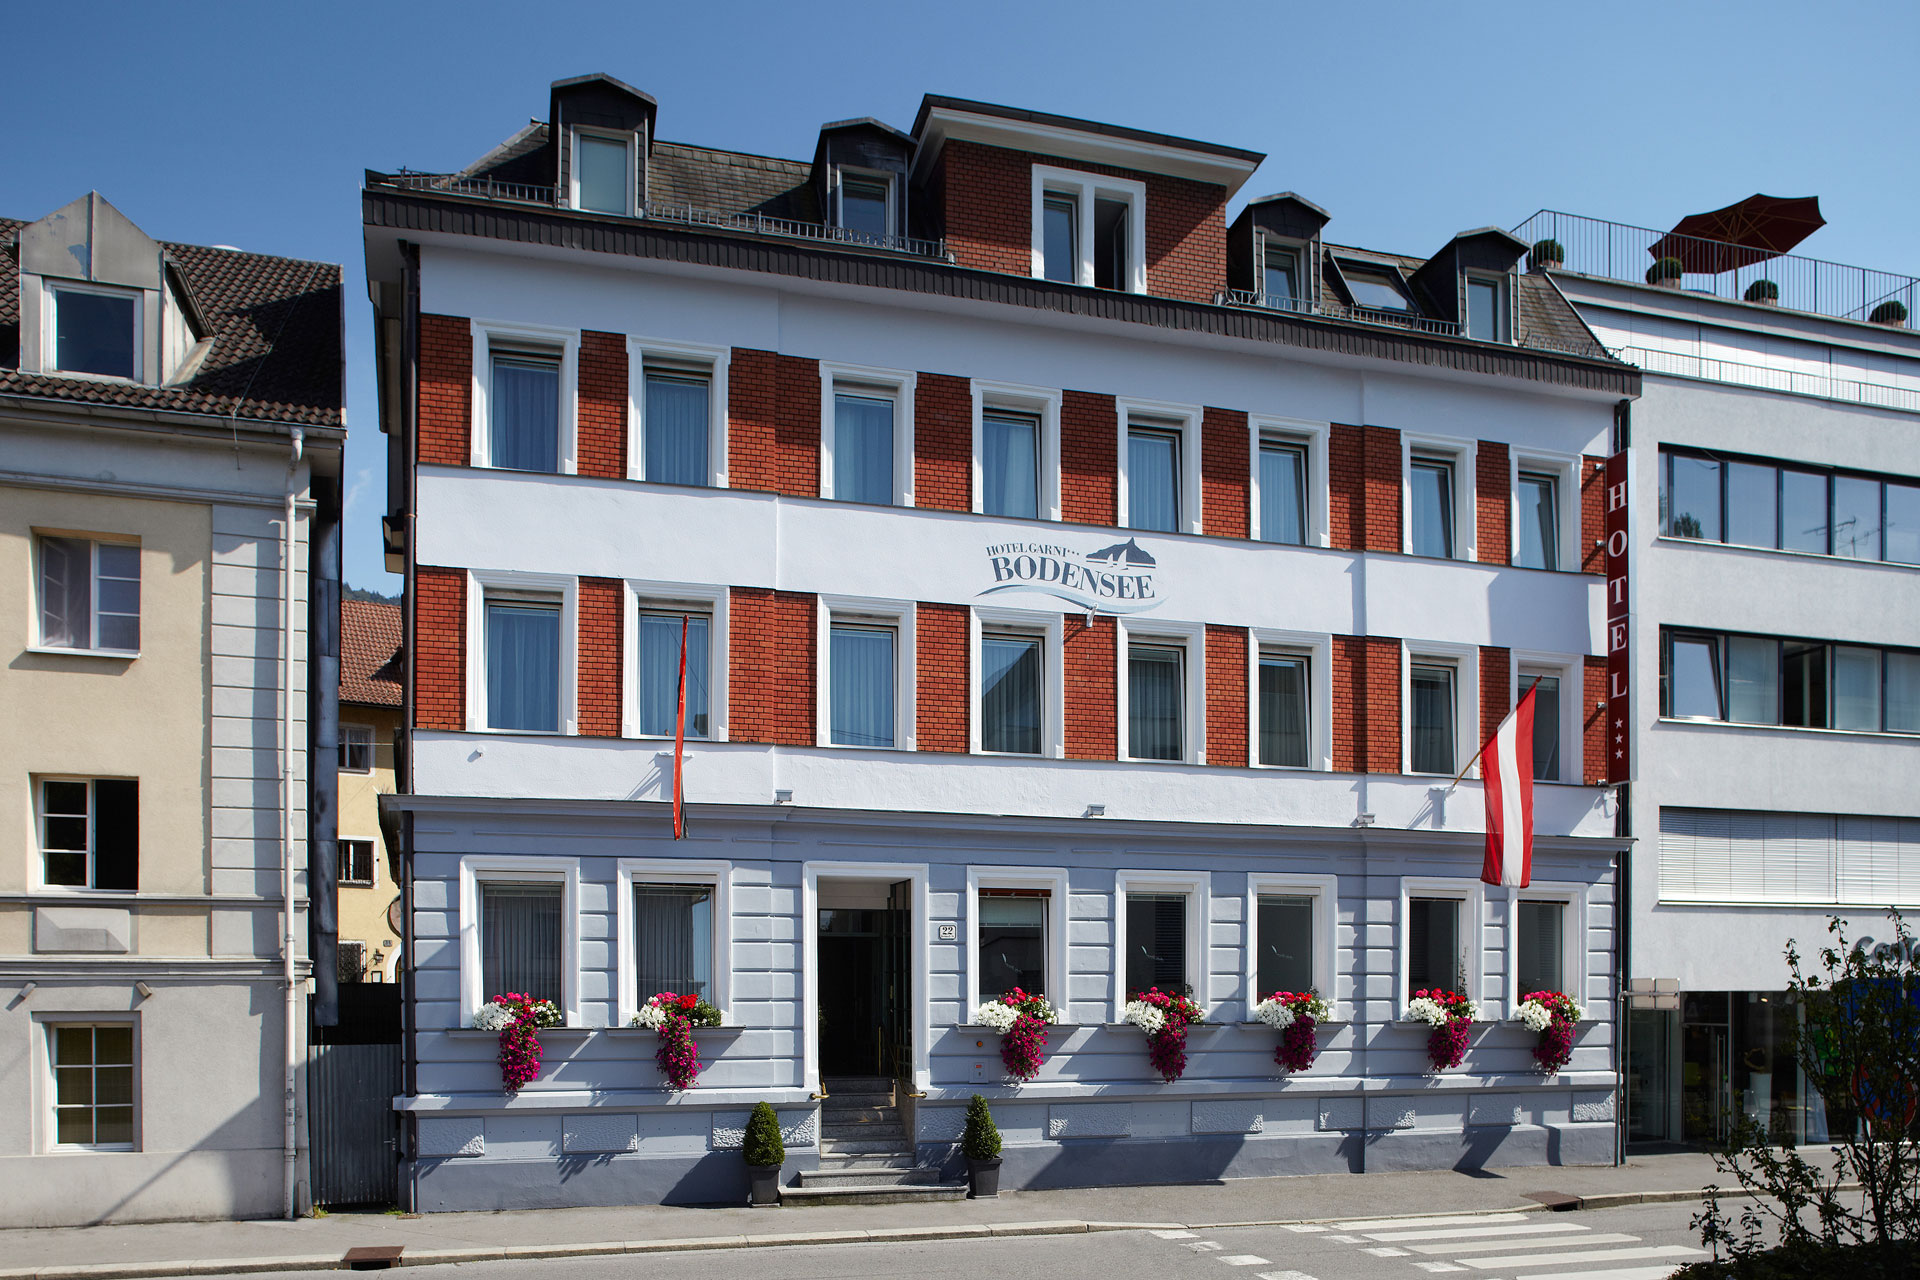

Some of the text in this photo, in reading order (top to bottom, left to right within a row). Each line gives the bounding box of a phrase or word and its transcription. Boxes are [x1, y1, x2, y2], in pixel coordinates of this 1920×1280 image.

[986, 542, 1029, 557] HOTEL
[990, 555, 1155, 599] BODENSEE
[1607, 480, 1628, 699] HOTEL
[942, 927, 953, 935] 22
